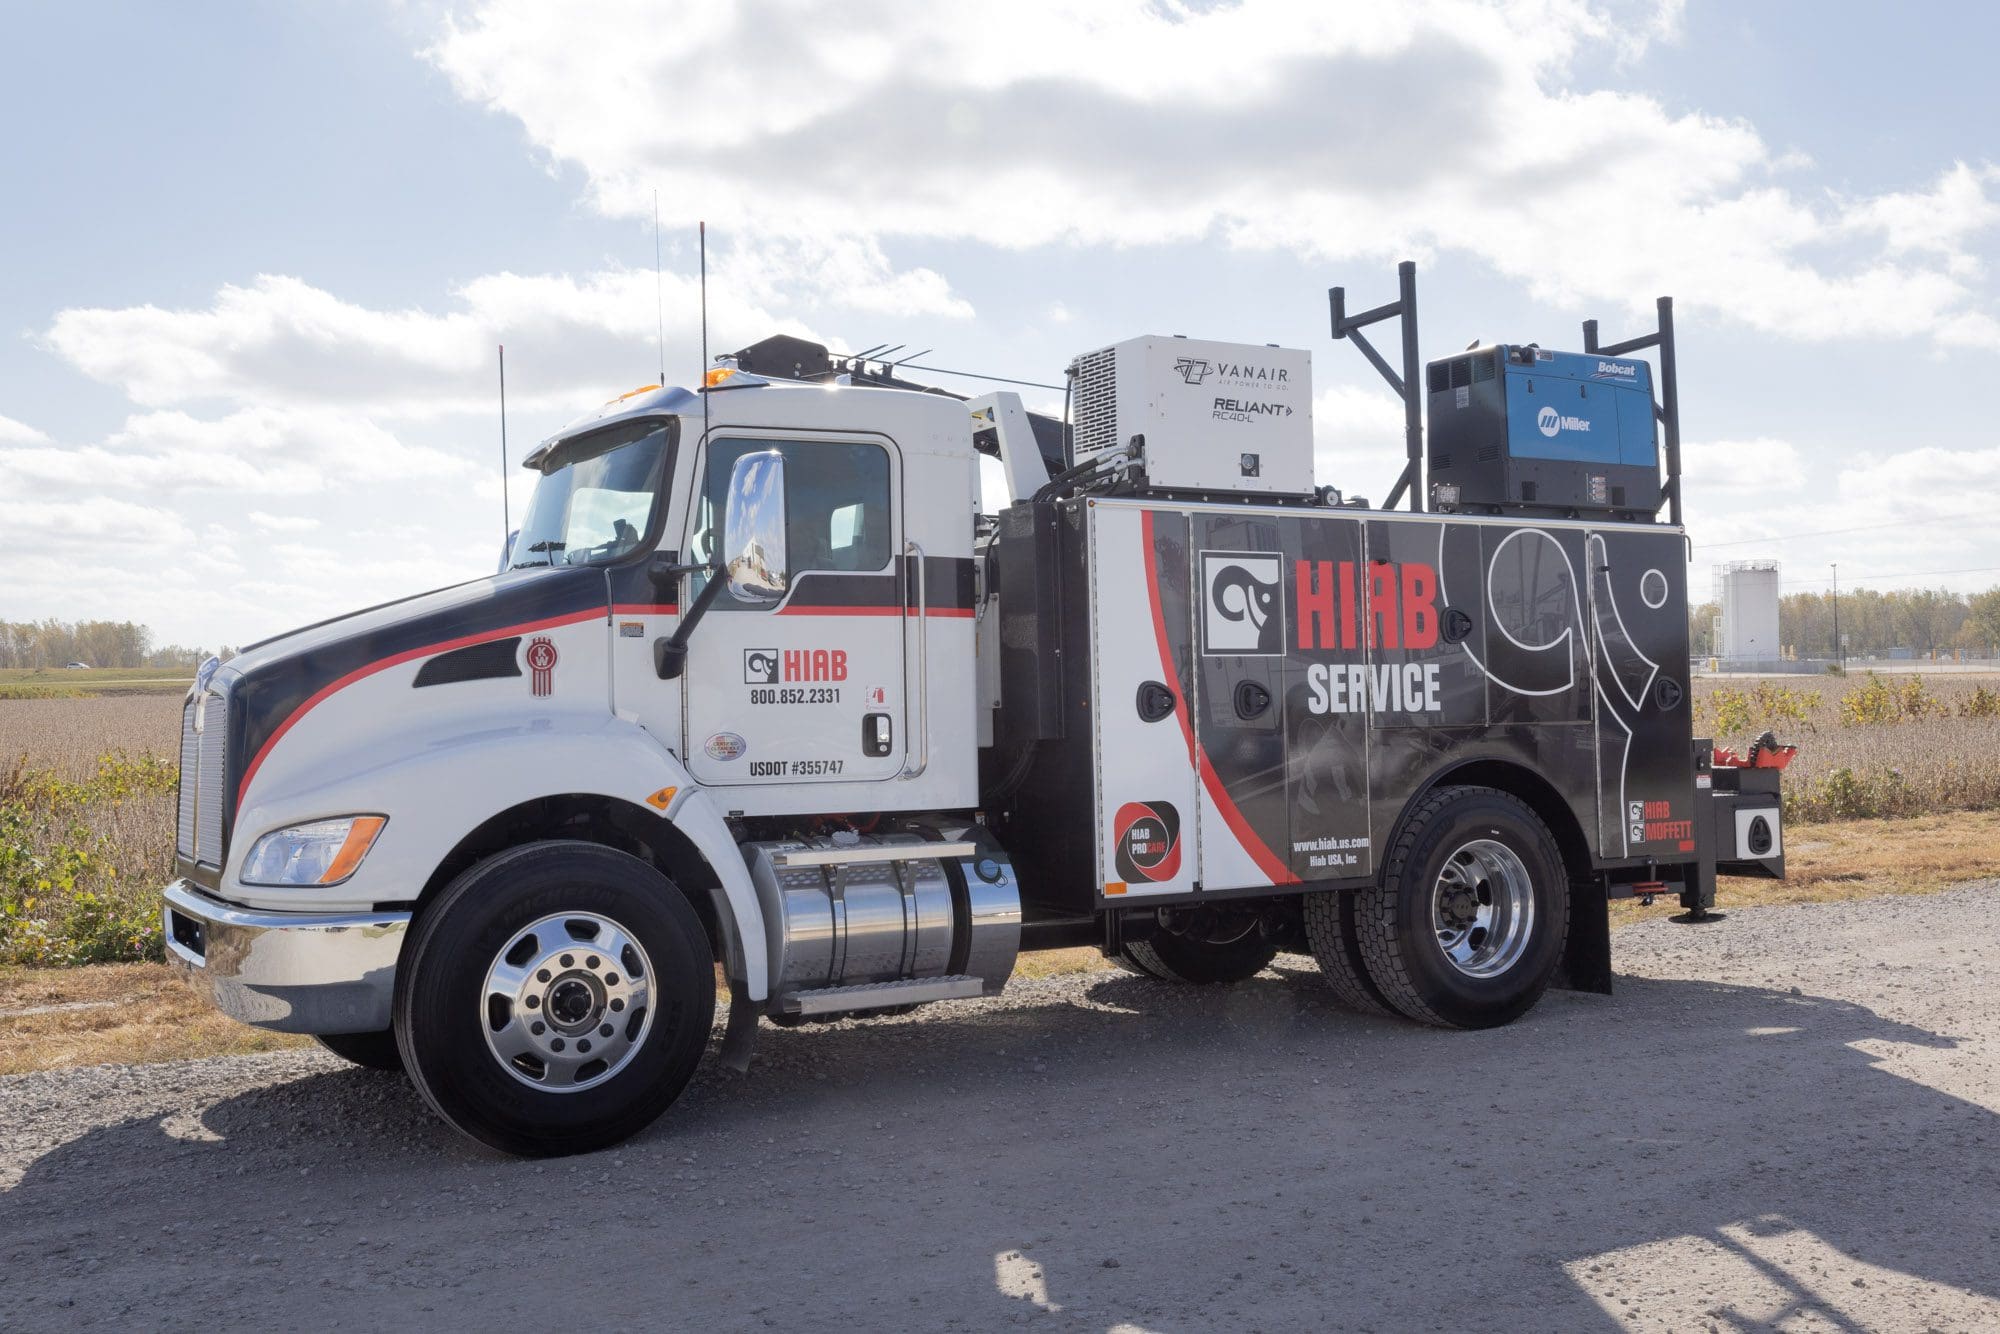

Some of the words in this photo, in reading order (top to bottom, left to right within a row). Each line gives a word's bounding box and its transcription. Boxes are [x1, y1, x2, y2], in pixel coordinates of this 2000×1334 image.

[1218, 363, 1288, 382] VANAIR
[1597, 361, 1636, 376] Bobcat
[1213, 397, 1285, 416] RELIANT
[1212, 410, 1254, 423] RC40-L
[1560, 415, 1591, 432] Miller
[1295, 559, 1439, 650] HIAB
[784, 650, 848, 682] HIAB
[750, 688, 840, 705] 800.852.2331
[1307, 663, 1441, 714] SERVICE
[750, 761, 788, 776] USDOT
[791, 760, 844, 775] #355747
[1645, 801, 1670, 819] HIAB
[1131, 828, 1150, 840] HIAB
[1645, 820, 1692, 840] MOFFETT
[1293, 837, 1369, 852] www.hiab.us.com
[1309, 854, 1327, 867] Hiab
[1327, 853, 1344, 867] USA,
[1345, 853, 1358, 865] Inc
